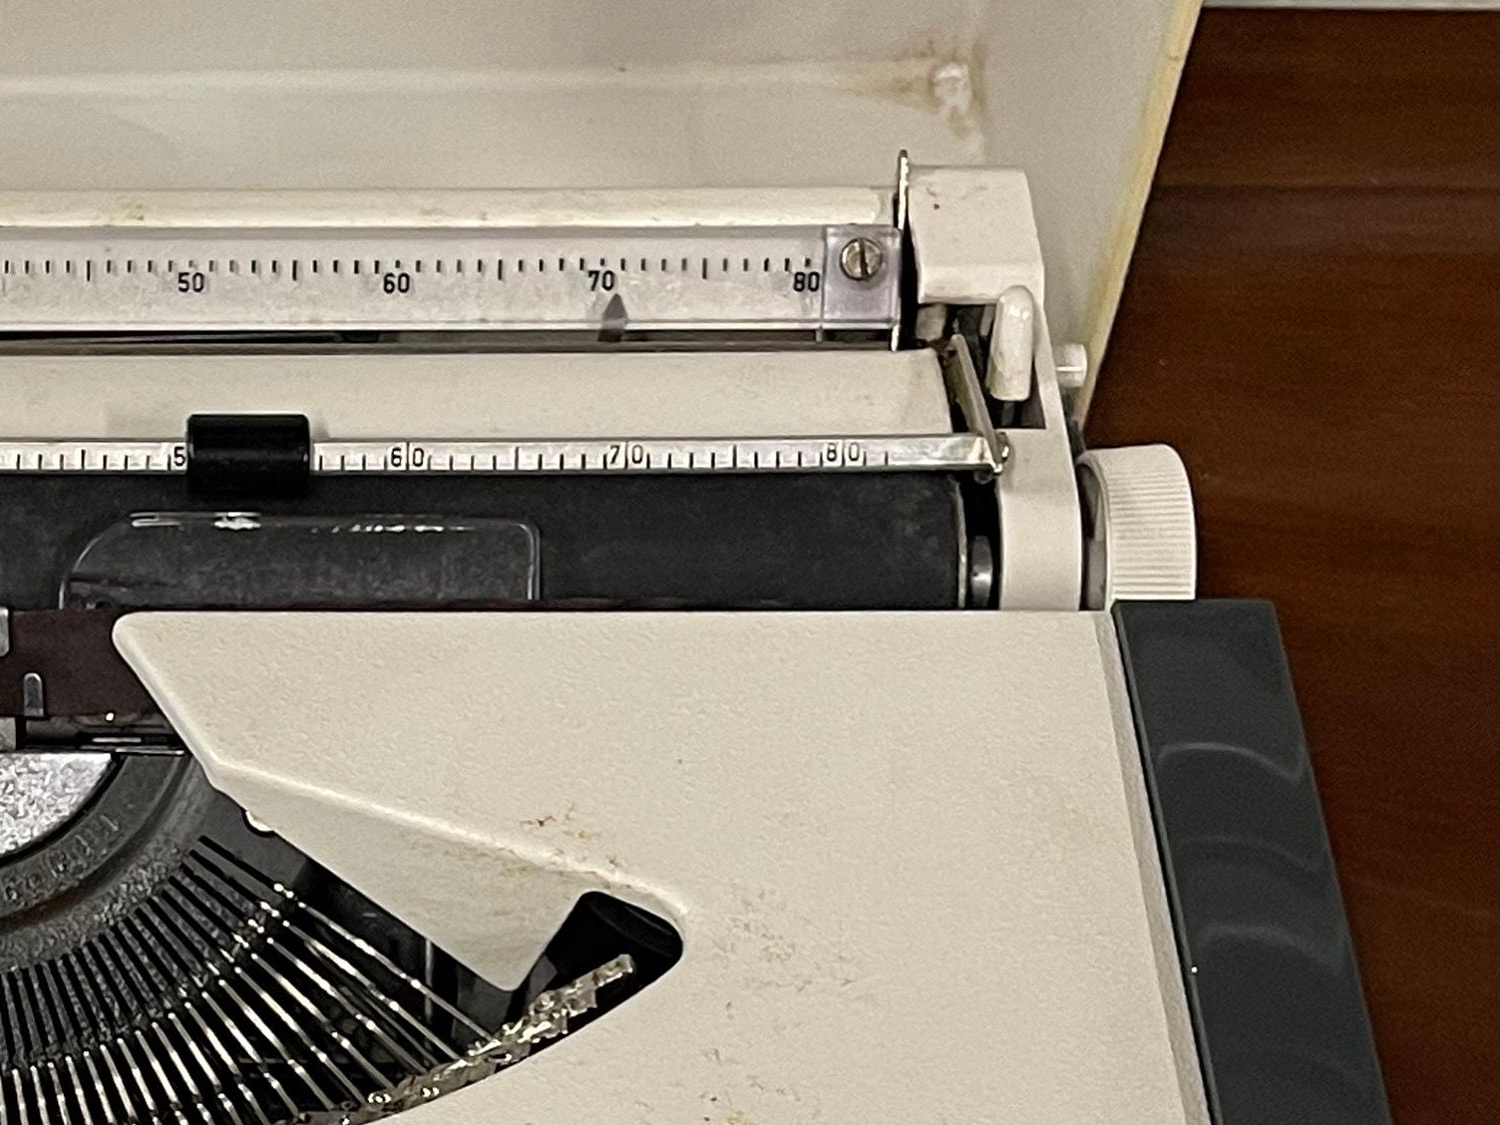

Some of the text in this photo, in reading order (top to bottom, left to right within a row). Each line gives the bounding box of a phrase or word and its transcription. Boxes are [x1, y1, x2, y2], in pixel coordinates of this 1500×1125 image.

[177, 271, 205, 293] 50
[383, 272, 411, 295] 60
[587, 269, 616, 292] 70
[792, 271, 821, 293] 80
[390, 445, 426, 469] 60
[608, 445, 646, 468] 70
[826, 443, 863, 467] 80
